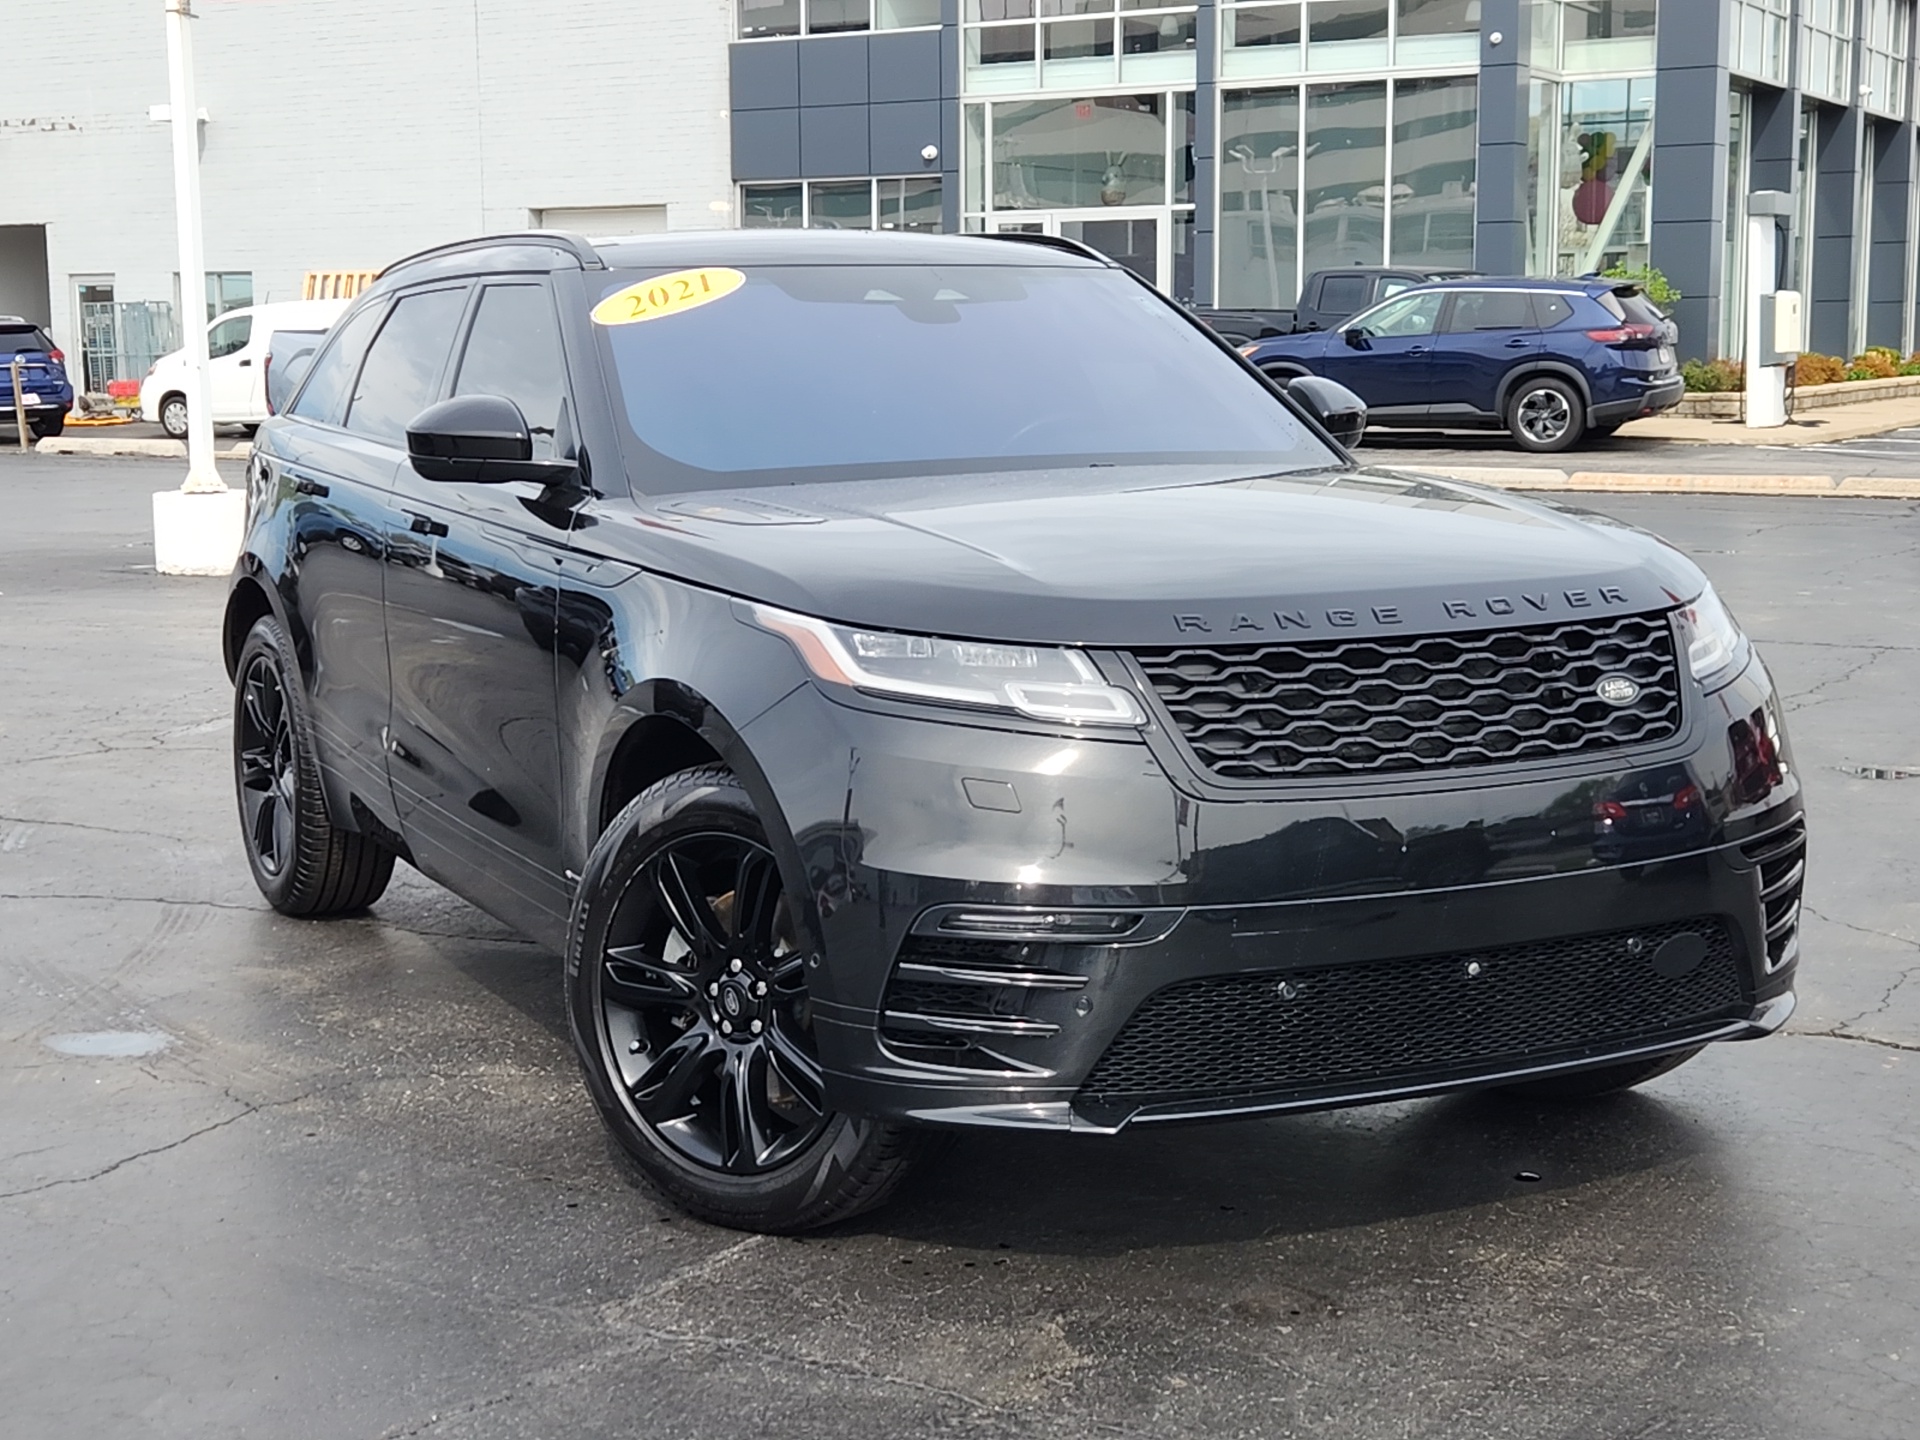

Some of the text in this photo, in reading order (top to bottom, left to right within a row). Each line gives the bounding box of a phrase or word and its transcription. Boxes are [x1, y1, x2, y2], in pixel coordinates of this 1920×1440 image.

[625, 273, 711, 318] 2021
[1173, 586, 1629, 633] RANGE ROVER
